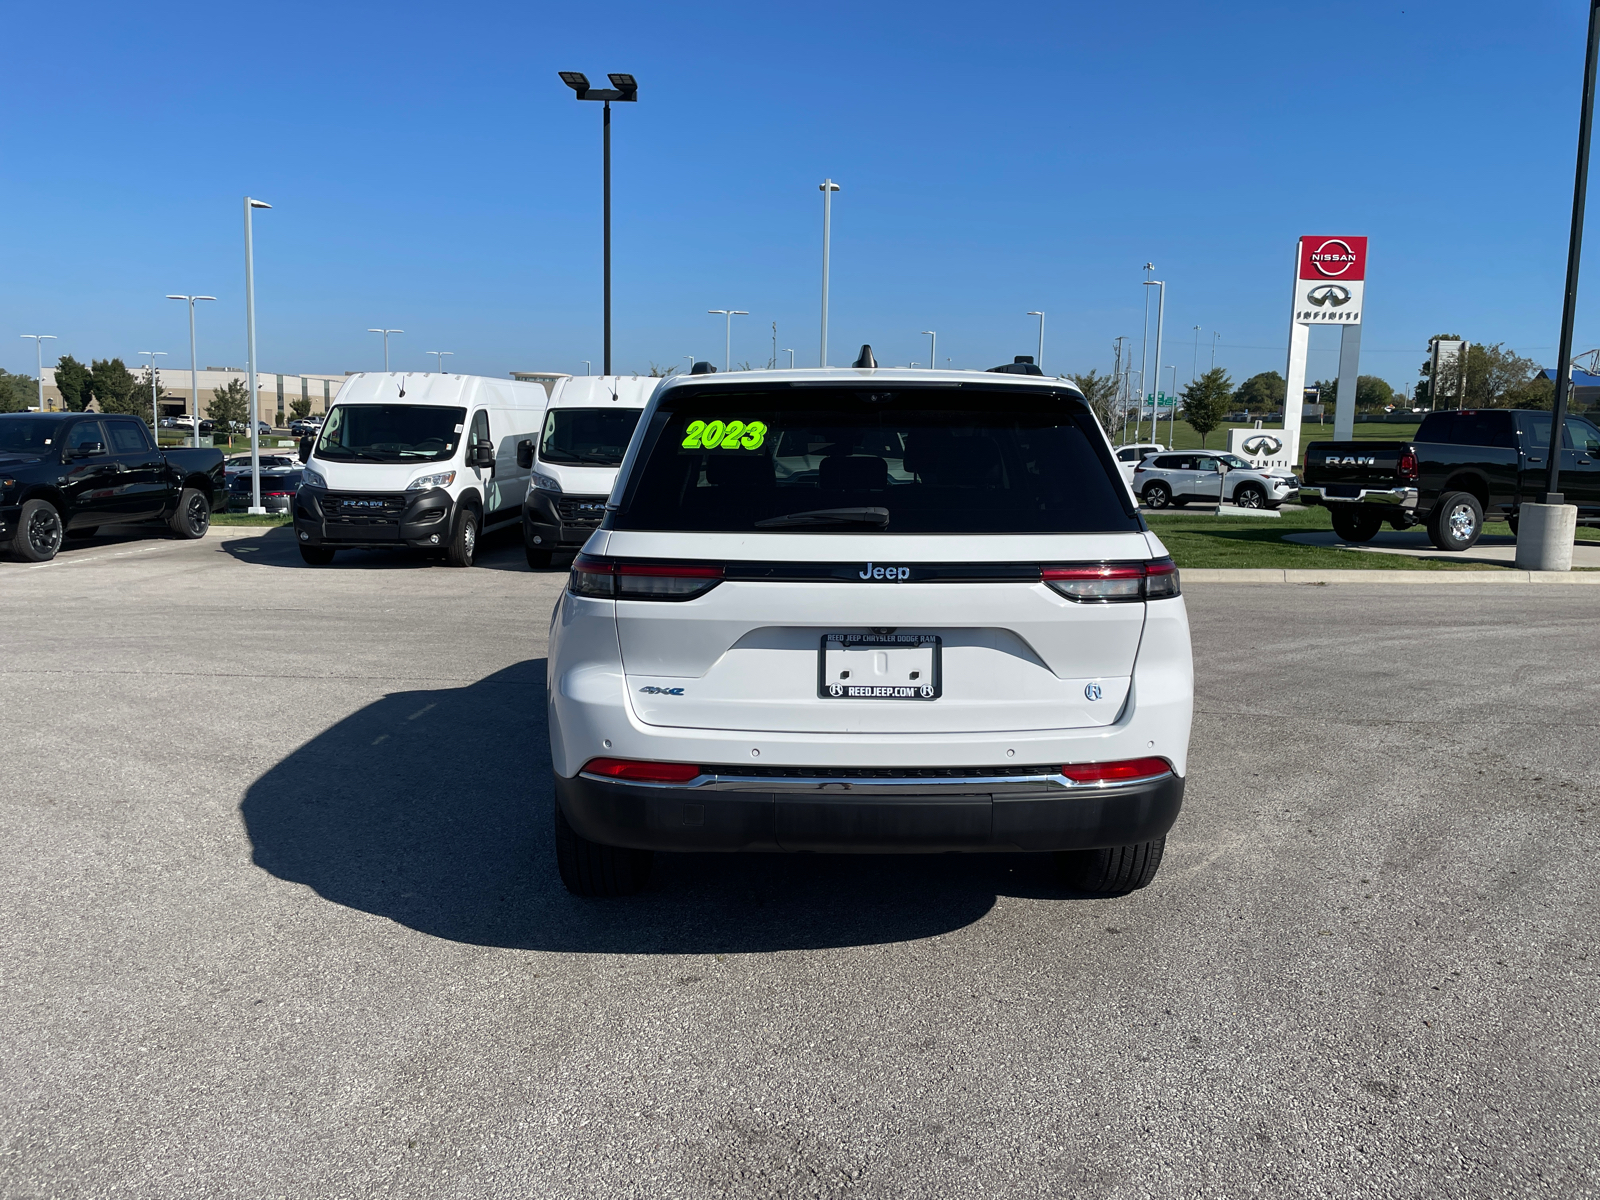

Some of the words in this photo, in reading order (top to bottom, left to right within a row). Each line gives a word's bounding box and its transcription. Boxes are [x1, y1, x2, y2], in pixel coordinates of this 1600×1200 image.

[1311, 254, 1356, 262] NISSAN
[1296, 311, 1359, 320] INFINITI
[681, 420, 767, 450] 2023
[1249, 459, 1288, 467] FINITI
[1325, 456, 1375, 465] RAM
[859, 562, 910, 582] Jeep
[846, 634, 861, 642] JEEP
[848, 686, 915, 697] REEDJEEP.COM
